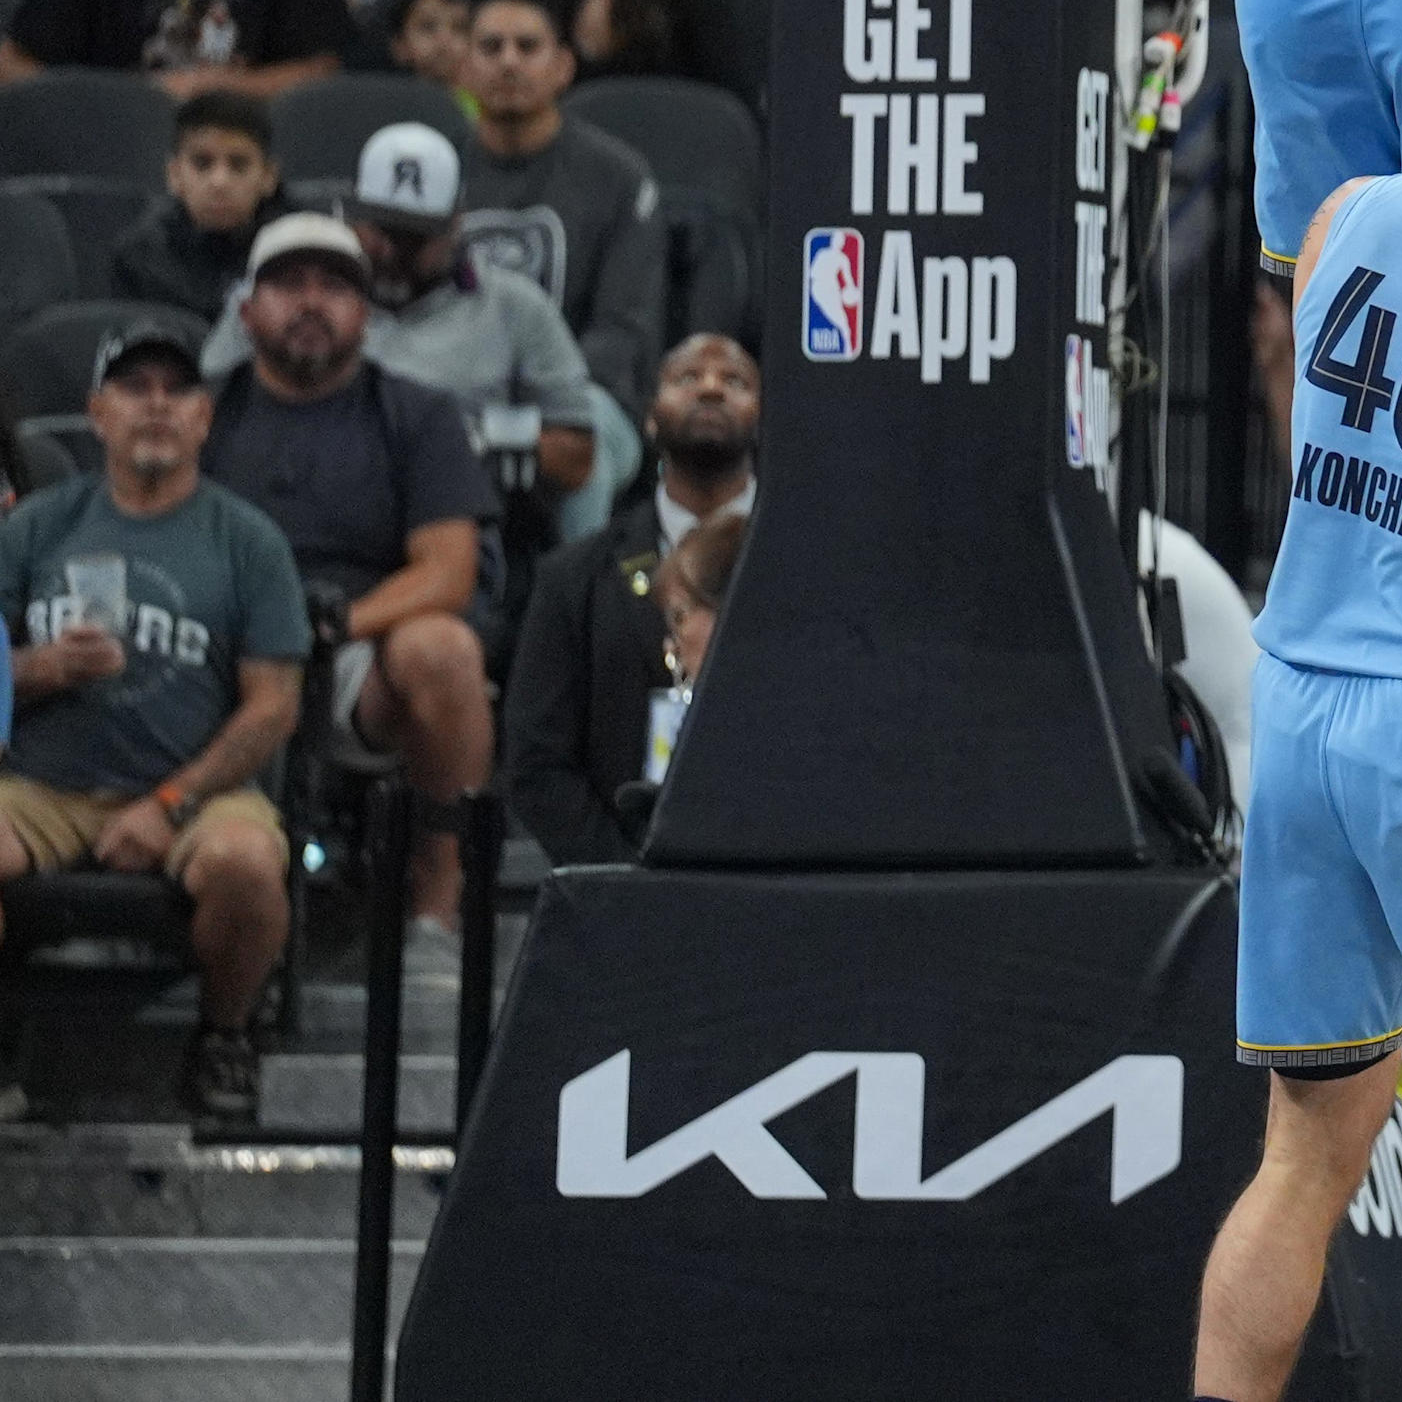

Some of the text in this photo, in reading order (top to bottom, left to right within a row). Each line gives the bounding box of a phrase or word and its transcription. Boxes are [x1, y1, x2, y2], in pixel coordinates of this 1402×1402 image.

[840, 94, 986, 216] THE
[1076, 67, 1109, 192] GET
[810, 230, 1017, 384] NBA App
[556, 1048, 1184, 1205] KIA
